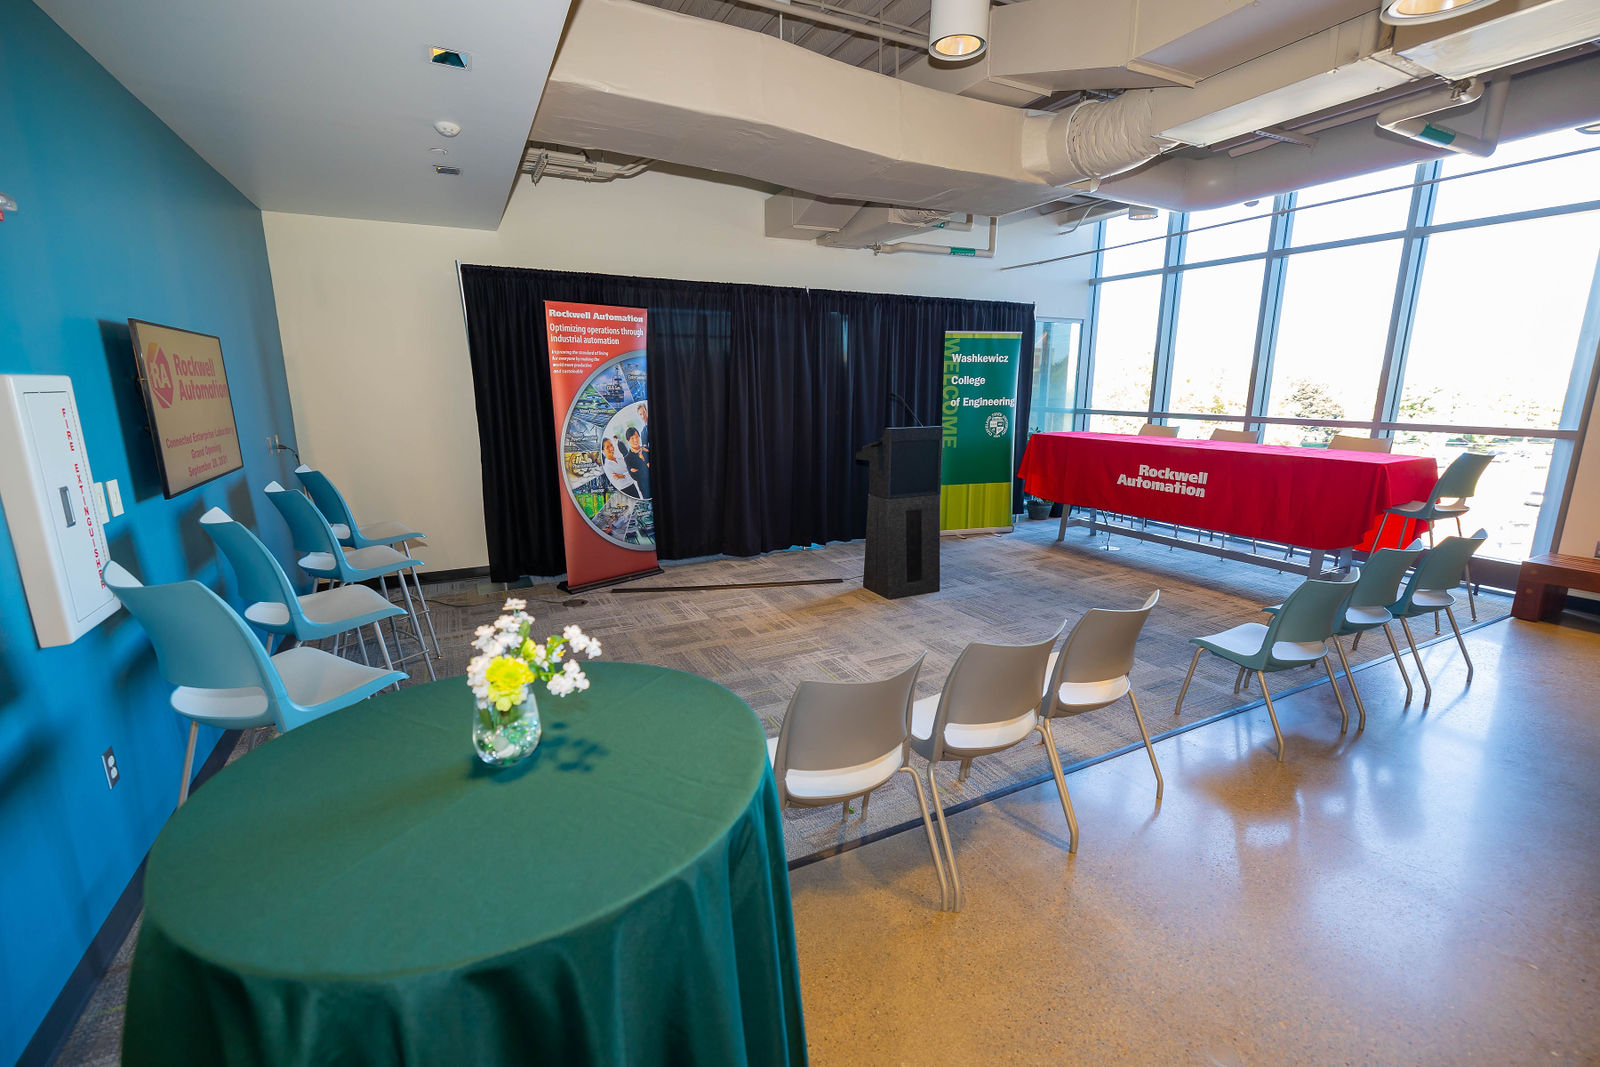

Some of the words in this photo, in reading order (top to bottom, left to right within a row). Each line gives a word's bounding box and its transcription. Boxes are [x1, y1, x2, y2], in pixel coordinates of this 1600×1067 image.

[548, 309, 591, 320] Rockwell
[592, 311, 643, 323] Automation
[549, 322, 586, 335] Optimizing
[587, 325, 620, 335] operations
[620, 327, 644, 338] through
[550, 333, 583, 344] industrial
[583, 335, 620, 345] automation
[172, 353, 216, 377] Rockwell
[951, 353, 1009, 363] Washkewicz
[178, 379, 229, 401] Automation
[951, 375, 986, 387] College
[942, 338, 960, 448] WELCOME
[950, 397, 961, 407] of
[963, 397, 1016, 408] Engineering
[61, 407, 75, 452] FIRE
[1138, 464, 1208, 485] Rockwell
[1116, 473, 1206, 498] Automation
